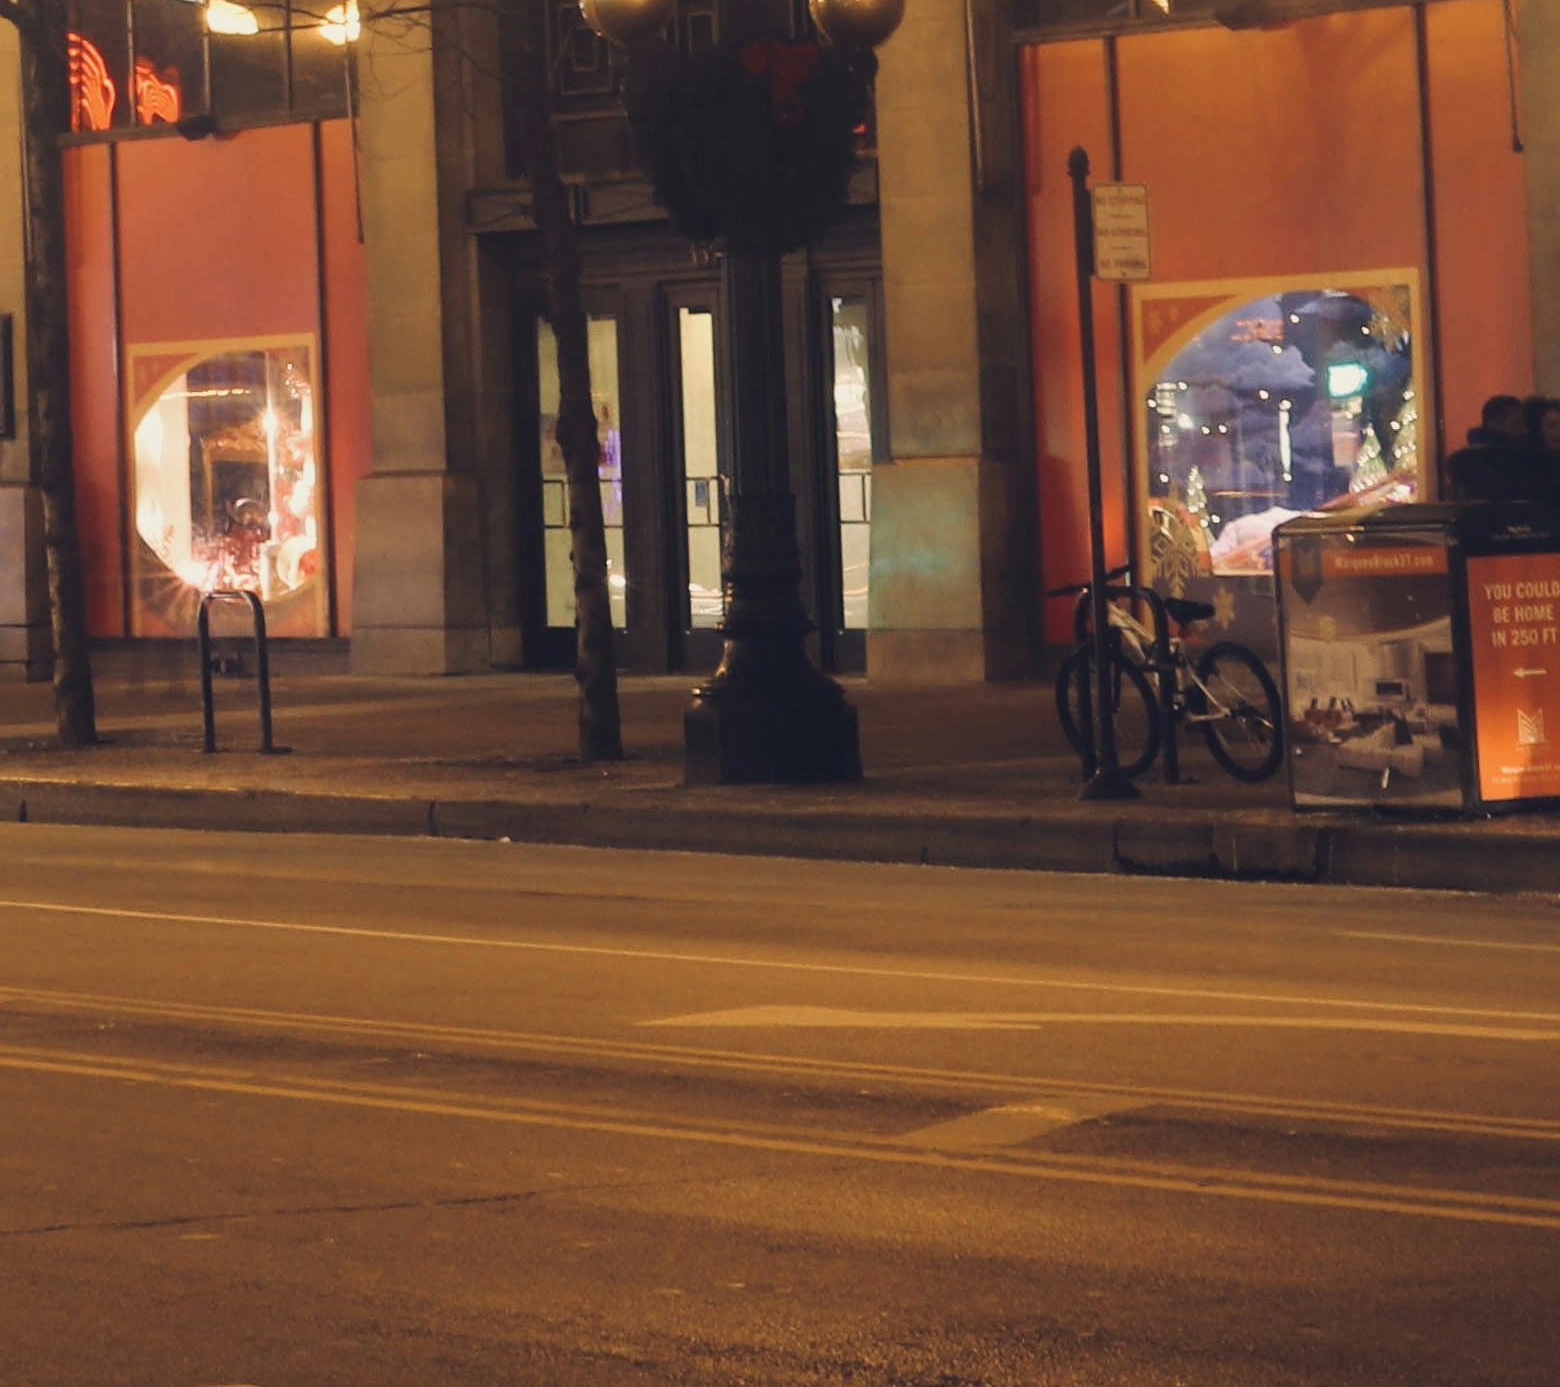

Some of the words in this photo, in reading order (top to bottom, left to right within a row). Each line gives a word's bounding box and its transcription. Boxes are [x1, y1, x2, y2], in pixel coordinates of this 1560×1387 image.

[1483, 583, 1512, 601] YOU
[1493, 607, 1510, 624] BE
[1514, 604, 1554, 622] HOME
[1491, 630, 1507, 647] IN
[1510, 629, 1539, 646] 250
[1541, 627, 1558, 644] FT
